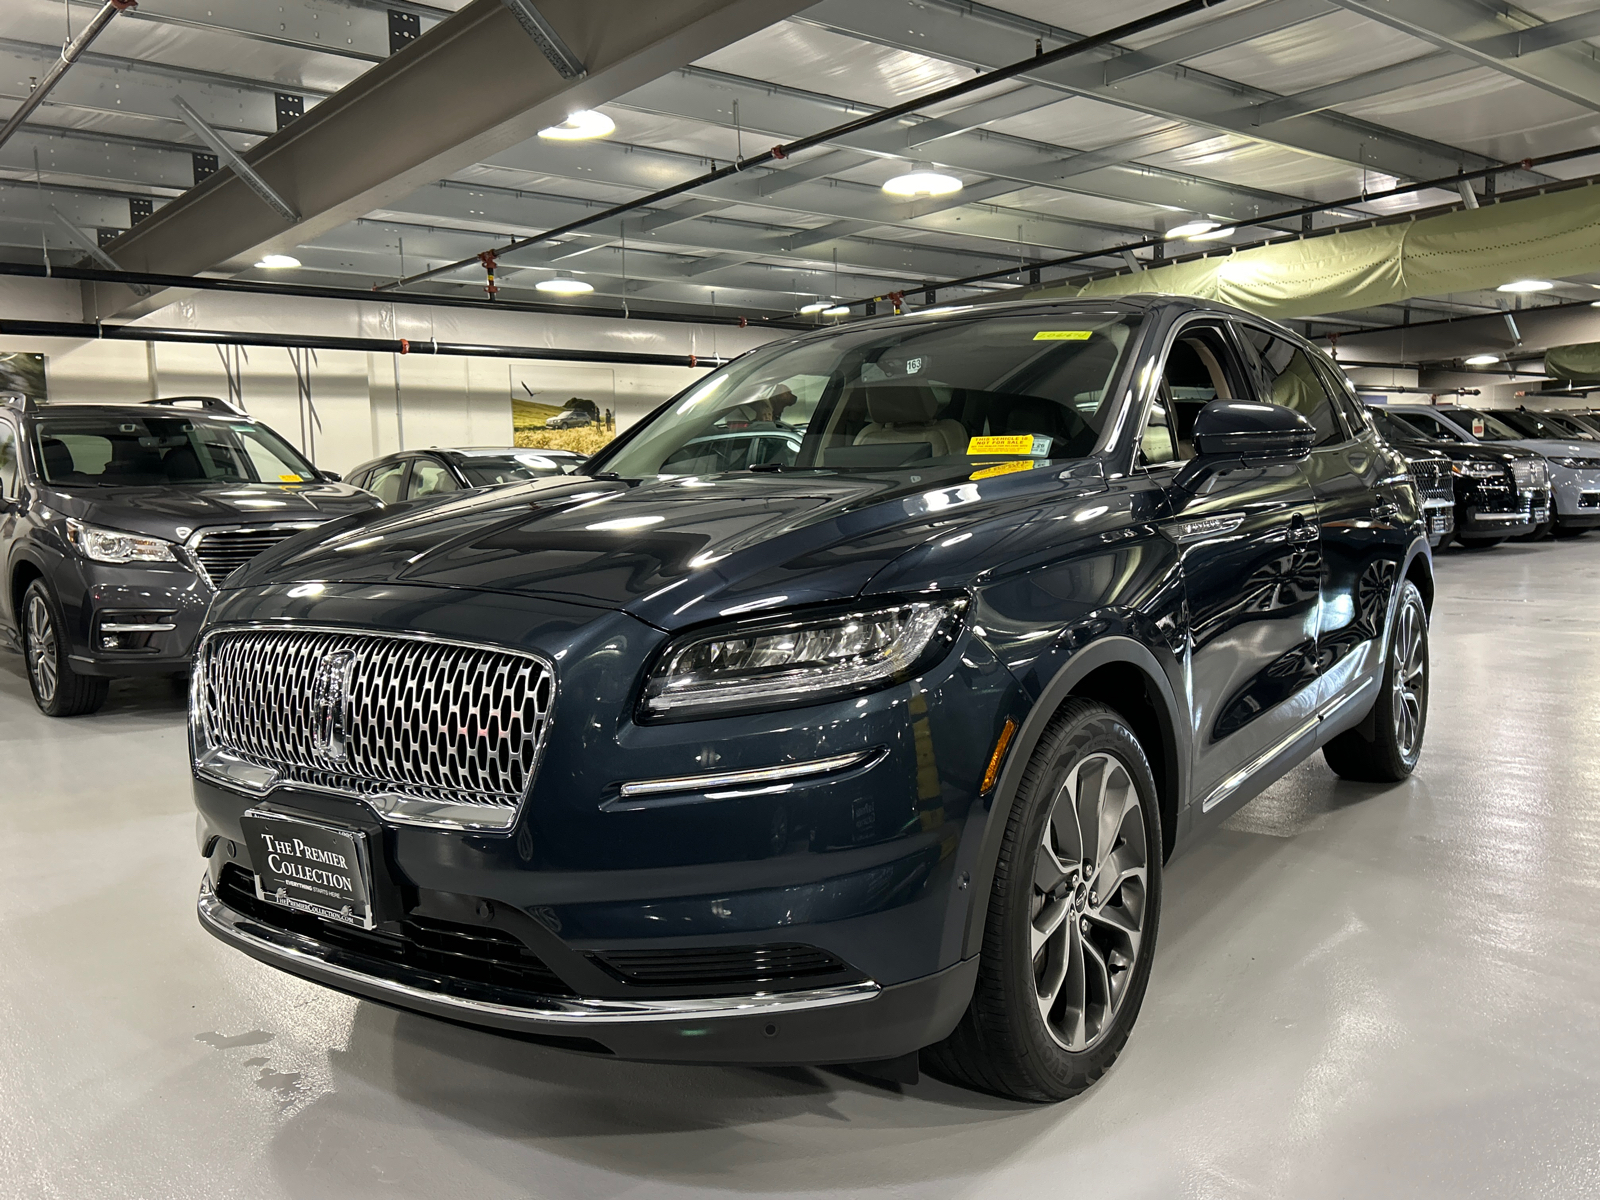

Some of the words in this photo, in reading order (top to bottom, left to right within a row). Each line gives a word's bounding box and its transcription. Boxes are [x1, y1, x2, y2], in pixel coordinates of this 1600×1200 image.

[908, 359, 921, 370] 163
[261, 833, 294, 856] THE
[292, 838, 348, 869] PREMIER
[267, 854, 353, 892] COLLECTION
[285, 880, 313, 891] EVERYTHING
[313, 886, 329, 896] STARTS
